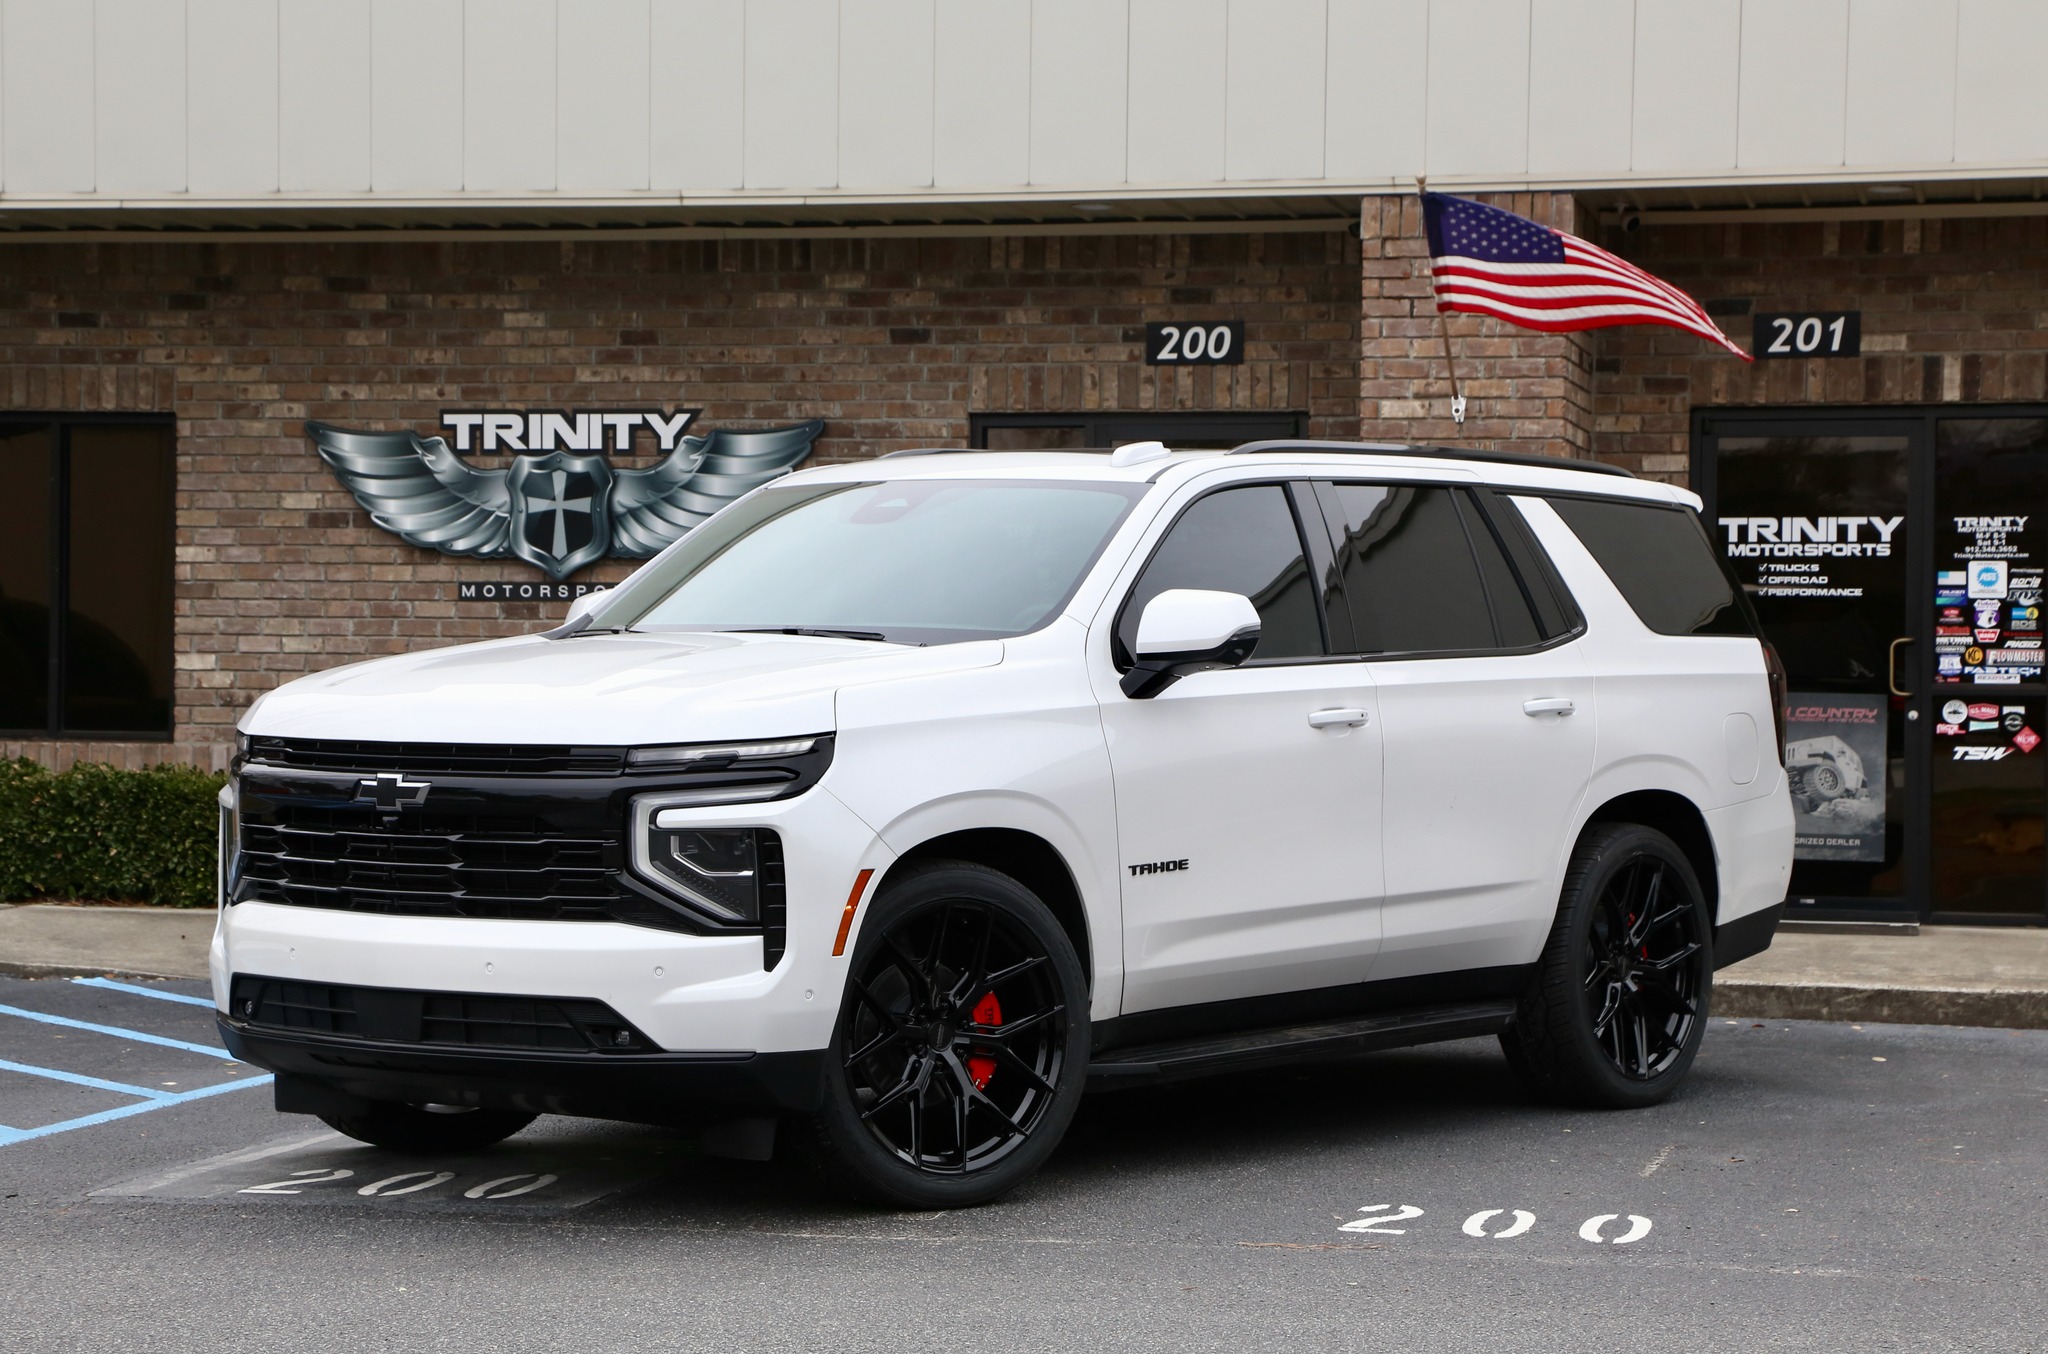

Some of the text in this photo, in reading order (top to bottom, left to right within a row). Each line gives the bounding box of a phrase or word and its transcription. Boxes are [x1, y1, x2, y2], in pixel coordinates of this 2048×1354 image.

[1767, 316, 1845, 353] 201
[1157, 326, 1232, 360] 200
[443, 413, 692, 450] TRINITY
[1953, 516, 2029, 527] TRINITY
[1718, 516, 1904, 543] TRINITY
[1728, 543, 1891, 557] MOTORSPORTS
[1768, 563, 1820, 572] TRUCKS
[1768, 576, 1828, 584] OFFROAD
[461, 584, 616, 598] MOTORSP
[1768, 588, 1863, 597] PERFORMANCE
[2007, 589, 2043, 602] FOX
[1968, 649, 1981, 663] KC
[1989, 651, 2044, 665] FLOWMASTER
[1964, 667, 2041, 676] FABTECH
[1795, 707, 1878, 719] COUNTRY
[1953, 746, 2016, 760] TSW
[1795, 837, 1861, 846] ORIZED DEALER
[1128, 859, 1189, 876] TAHOE
[1337, 1204, 1653, 1244] 200
